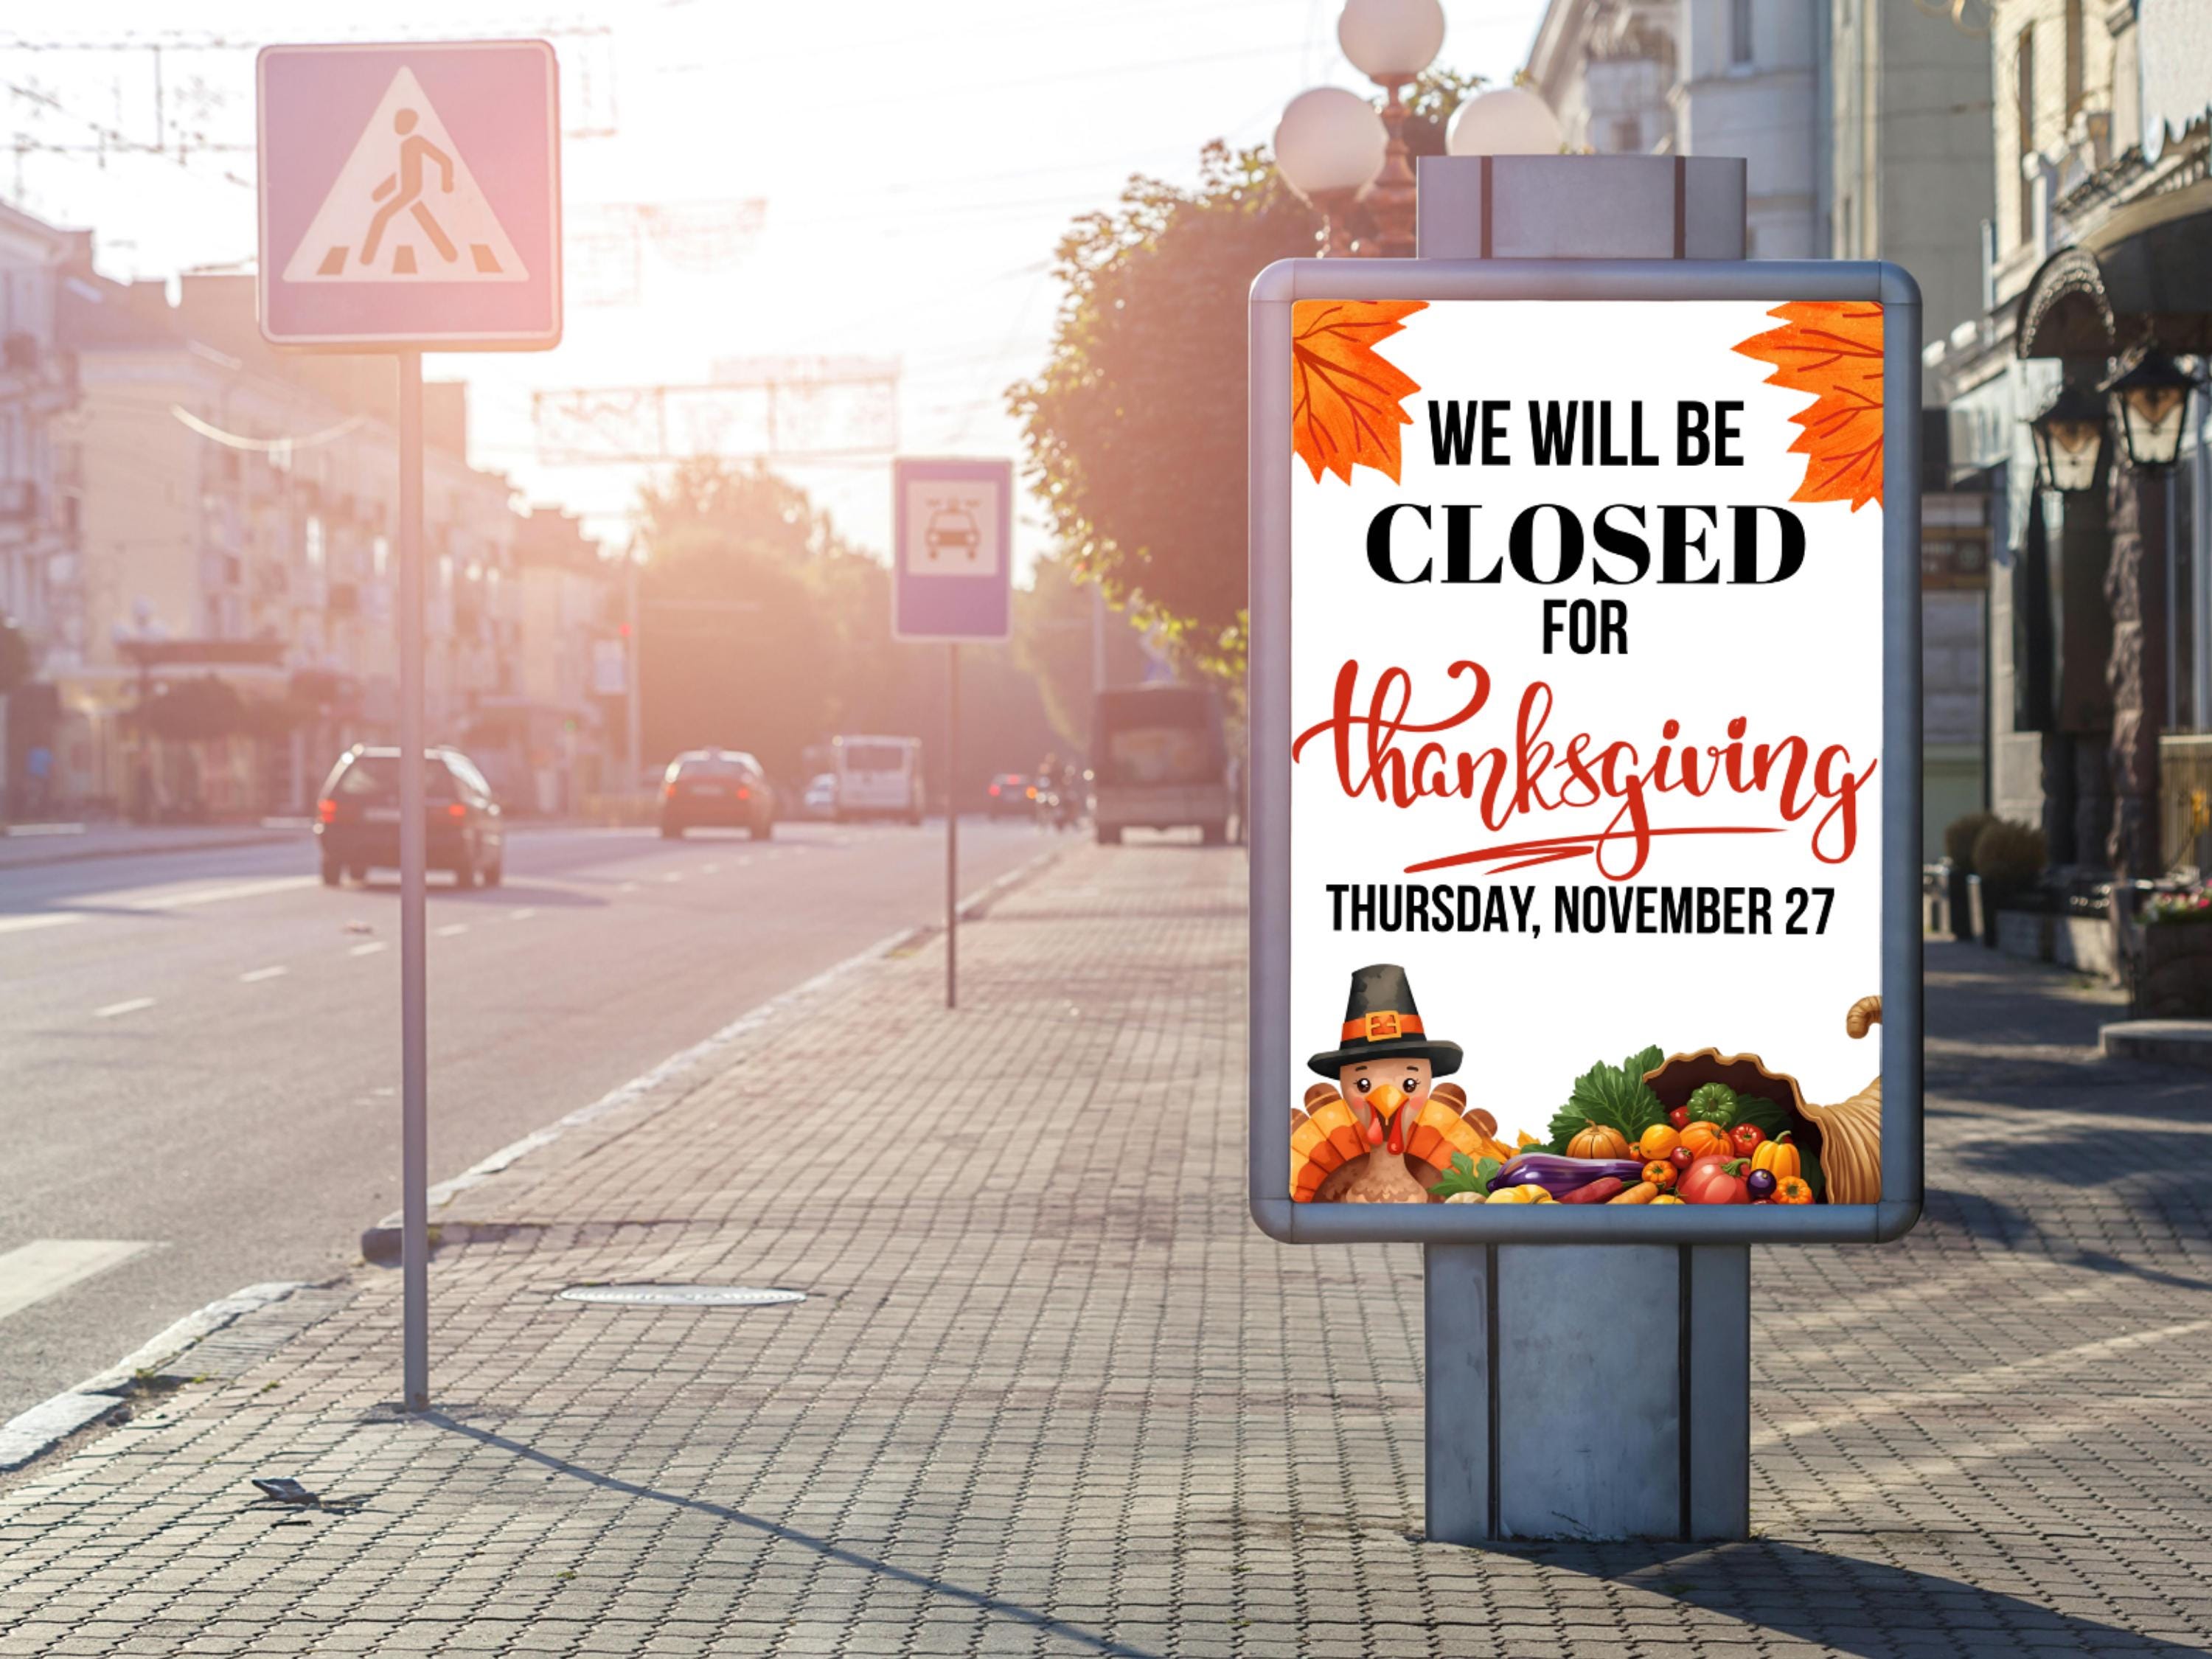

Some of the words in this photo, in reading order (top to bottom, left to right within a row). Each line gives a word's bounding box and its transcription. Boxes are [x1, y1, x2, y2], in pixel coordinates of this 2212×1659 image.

[1427, 400, 1511, 466] WE
[1528, 400, 1660, 466] WILL
[1677, 400, 1745, 467] BE
[1366, 503, 1806, 585] CLOSED
[1543, 598, 1628, 655] FOR
[1292, 659, 1877, 882] thanksgiving
[1326, 884, 1540, 939] THURSDAY,
[1554, 886, 1773, 935] NOVEMBER
[1785, 886, 1835, 935] 27
